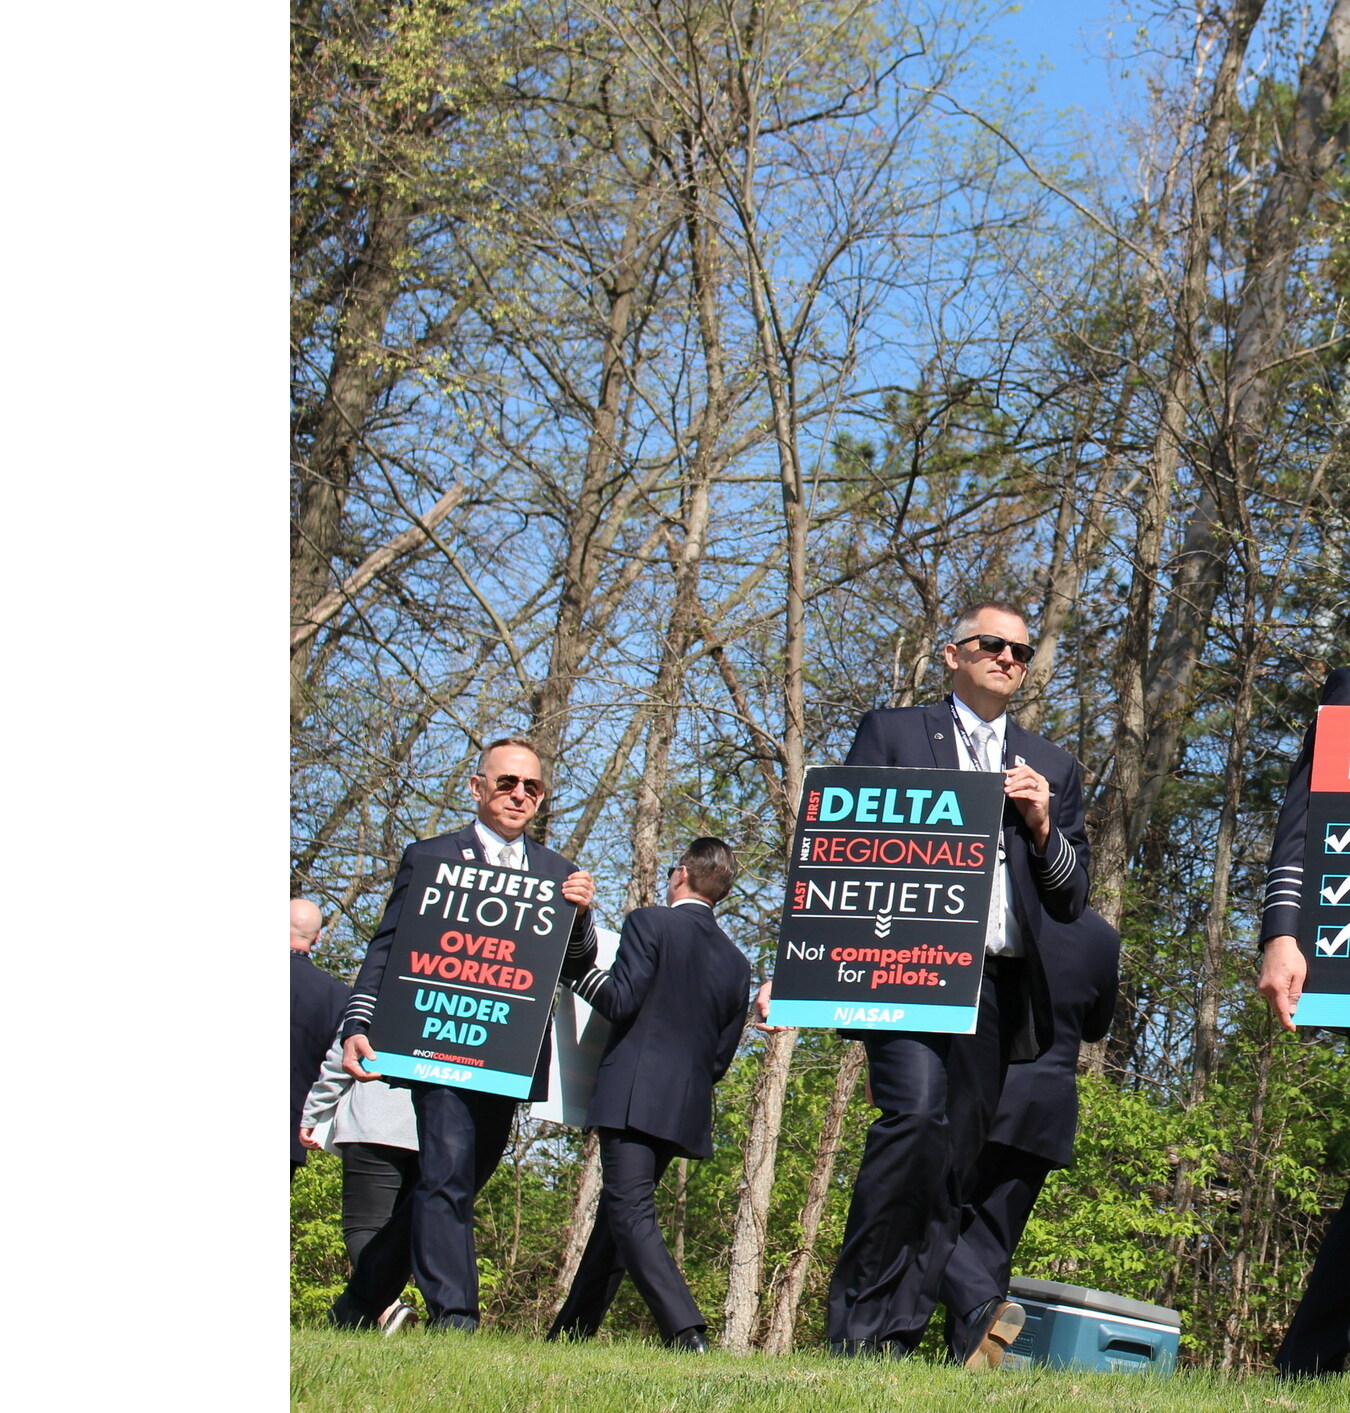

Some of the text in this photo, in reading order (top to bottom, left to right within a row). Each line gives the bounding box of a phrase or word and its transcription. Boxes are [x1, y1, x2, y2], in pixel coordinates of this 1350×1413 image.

[806, 790, 821, 822] FIRST
[819, 786, 964, 826] DELTA
[800, 837, 812, 861] NEXT
[812, 837, 985, 867] REGIONALS
[435, 863, 556, 902] NETJETS
[792, 880, 807, 910] LAST
[805, 879, 966, 915] NETJETS
[419, 887, 556, 936] PILOTS
[440, 930, 516, 962] OVER
[786, 941, 973, 967] Not competitive
[410, 951, 534, 991] WORKED
[837, 961, 947, 989] for pilots.
[414, 989, 511, 1025] UNDER
[834, 1007, 905, 1025] NJASAP
[421, 1017, 488, 1047] PAID
[413, 1063, 473, 1082] NJASAP
